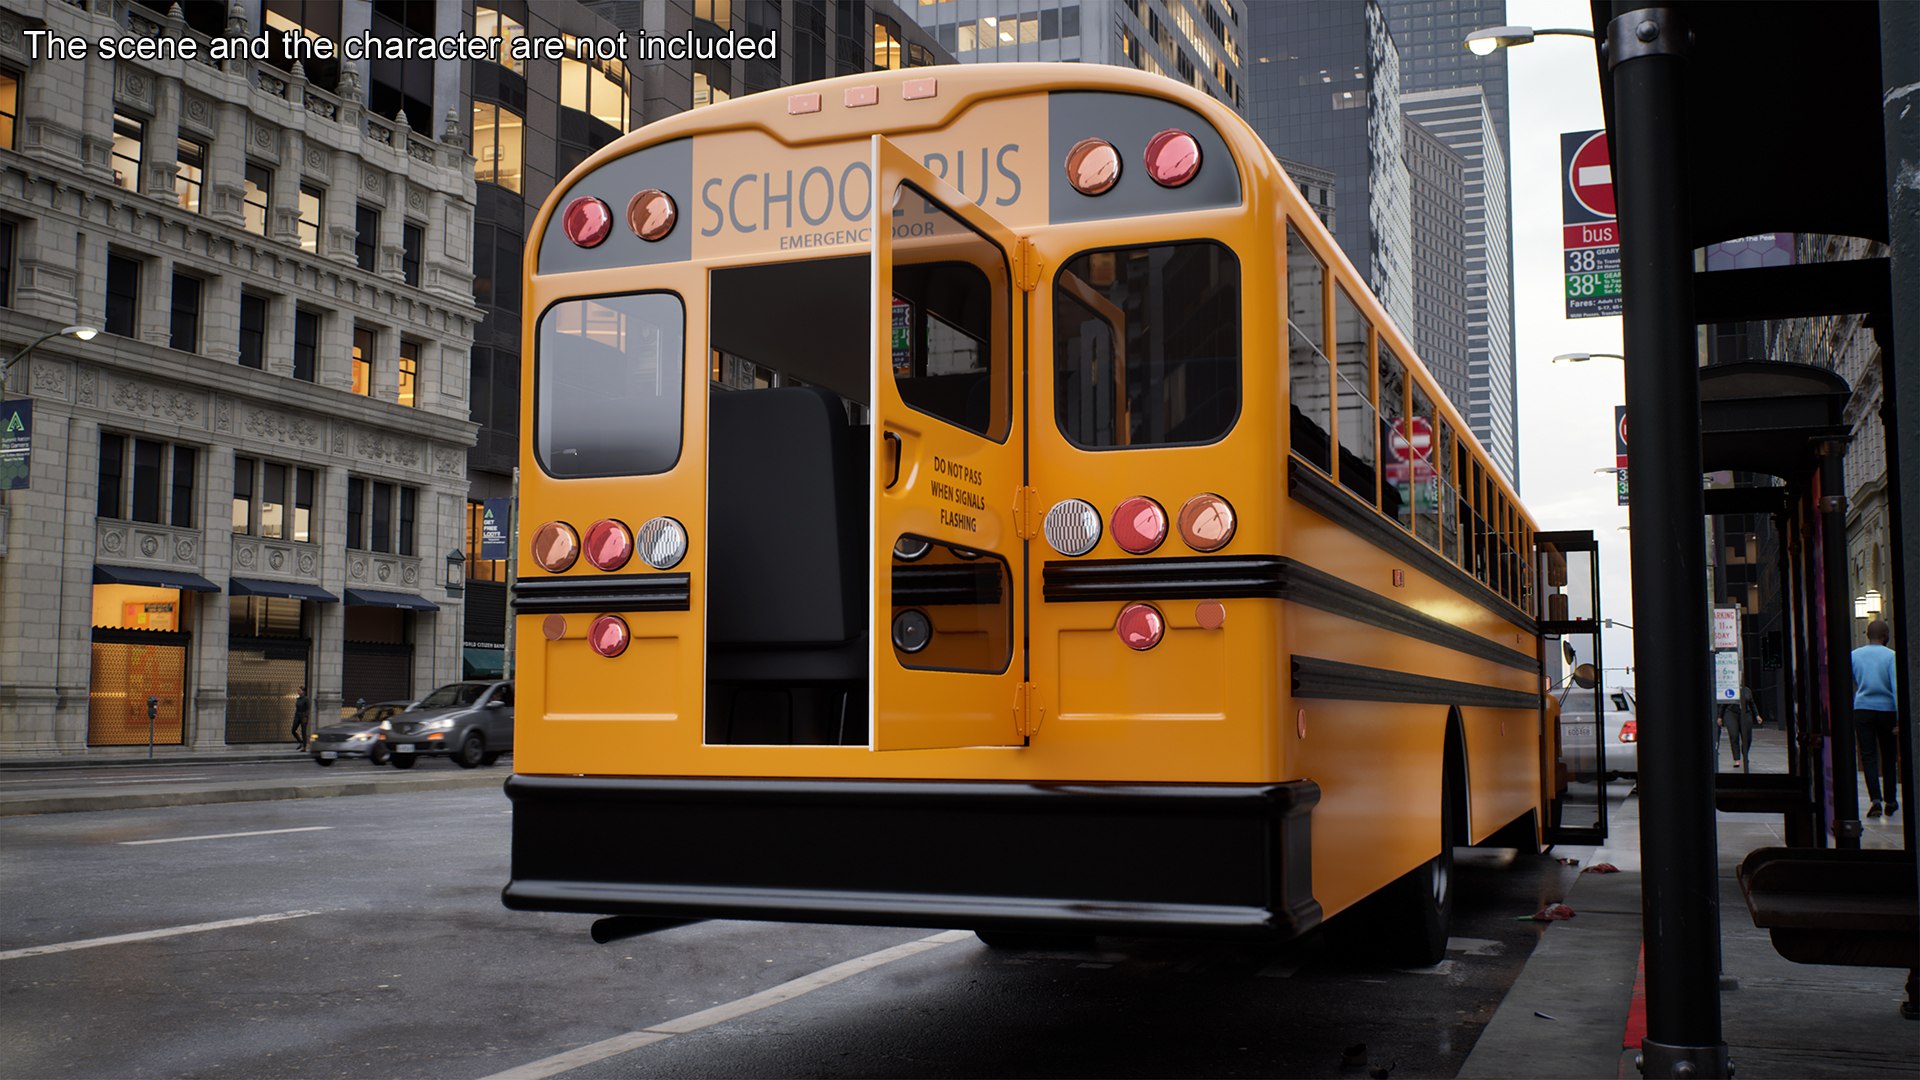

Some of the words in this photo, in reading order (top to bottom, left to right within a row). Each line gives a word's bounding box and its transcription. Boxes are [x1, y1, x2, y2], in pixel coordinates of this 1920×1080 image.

[701, 161, 904, 237] SCHOO
[780, 228, 872, 250] EMERGENC
[1583, 226, 1613, 243] bus
[1569, 250, 1595, 272] 38
[1569, 299, 1596, 308] Fares:
[934, 456, 946, 473] DO
[948, 460, 963, 480] NOT
[964, 466, 982, 486] PASS
[931, 480, 954, 501] WHEN
[955, 487, 985, 511] SIGNALS
[940, 508, 977, 532] FLASHING
